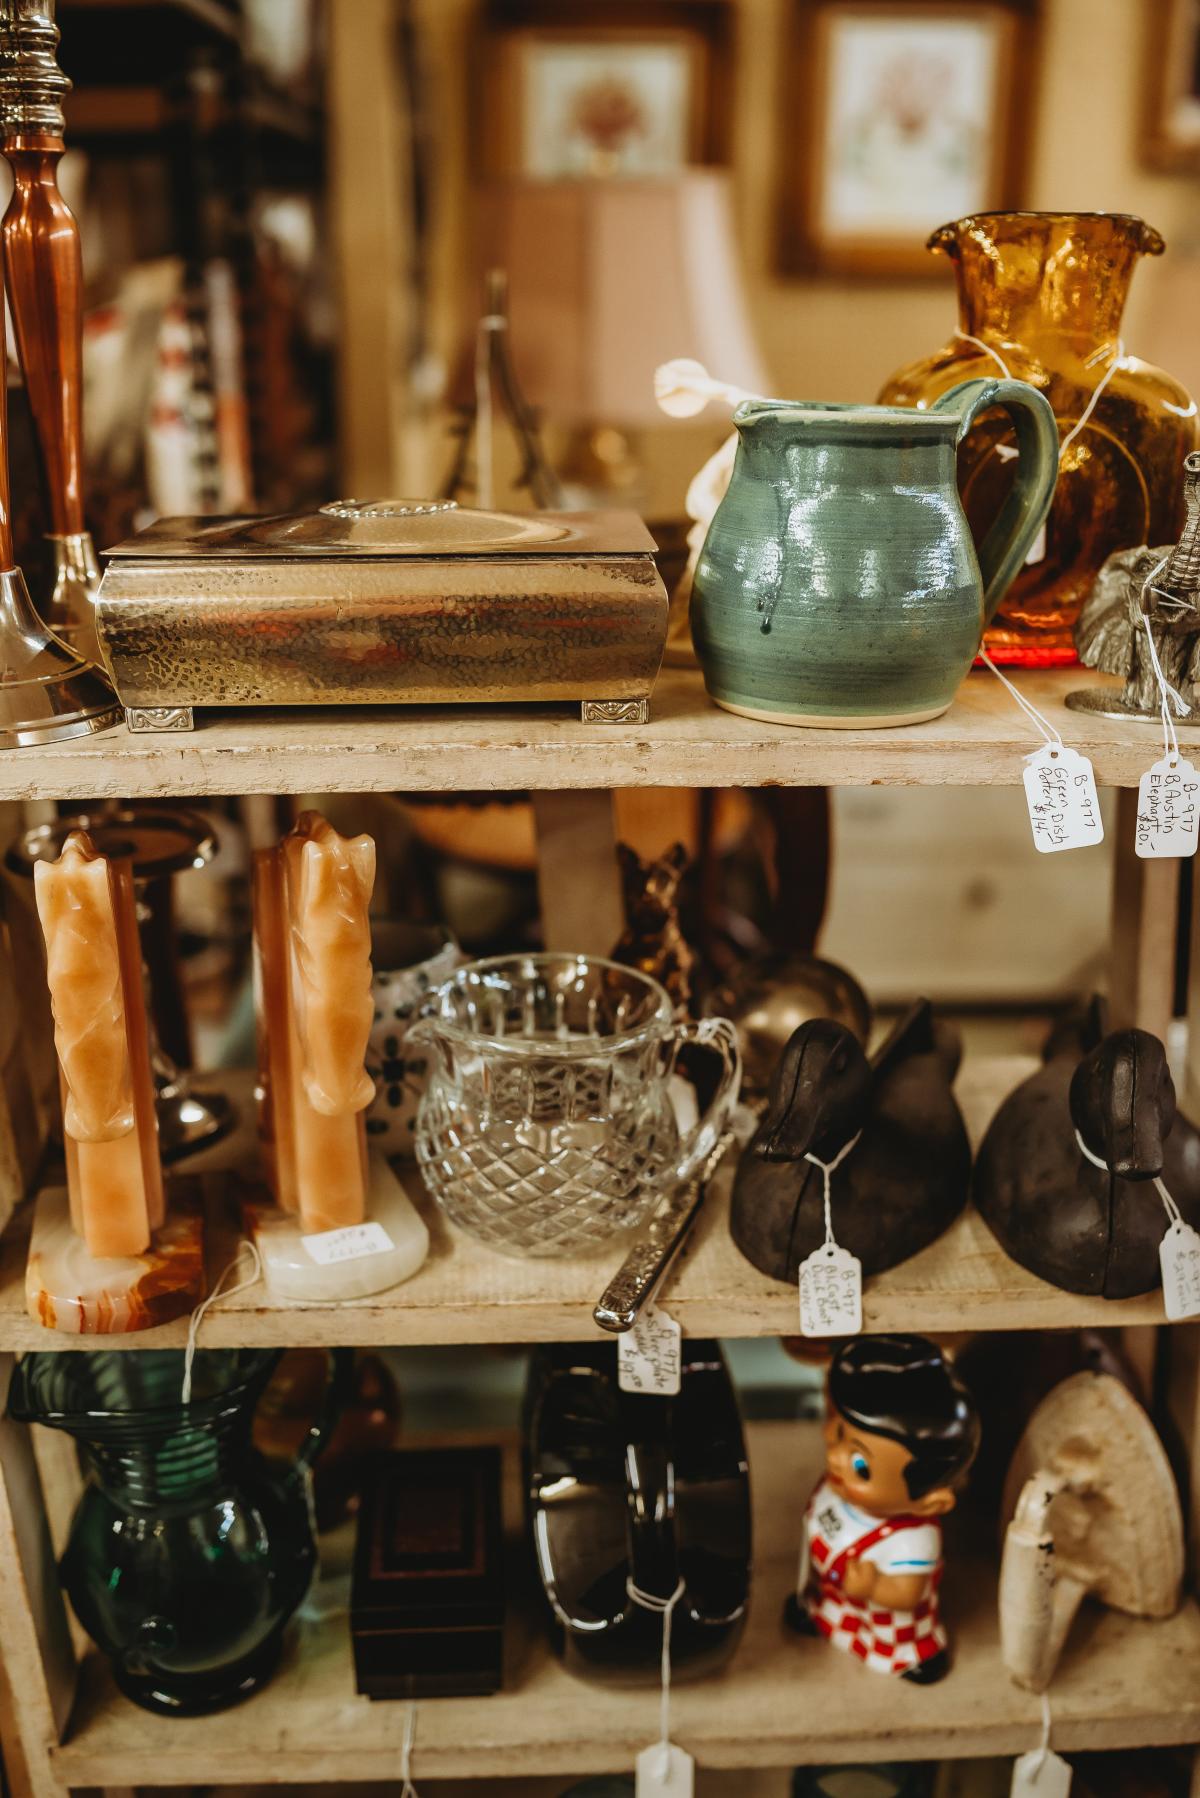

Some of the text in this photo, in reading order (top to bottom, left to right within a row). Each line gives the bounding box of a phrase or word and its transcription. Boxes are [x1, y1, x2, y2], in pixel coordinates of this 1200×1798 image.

[1051, 768, 1070, 845] Green Dish
[1074, 774, 1096, 827] B-977
[1147, 774, 1162, 833] Elephant
[1180, 783, 1198, 833] B-977
